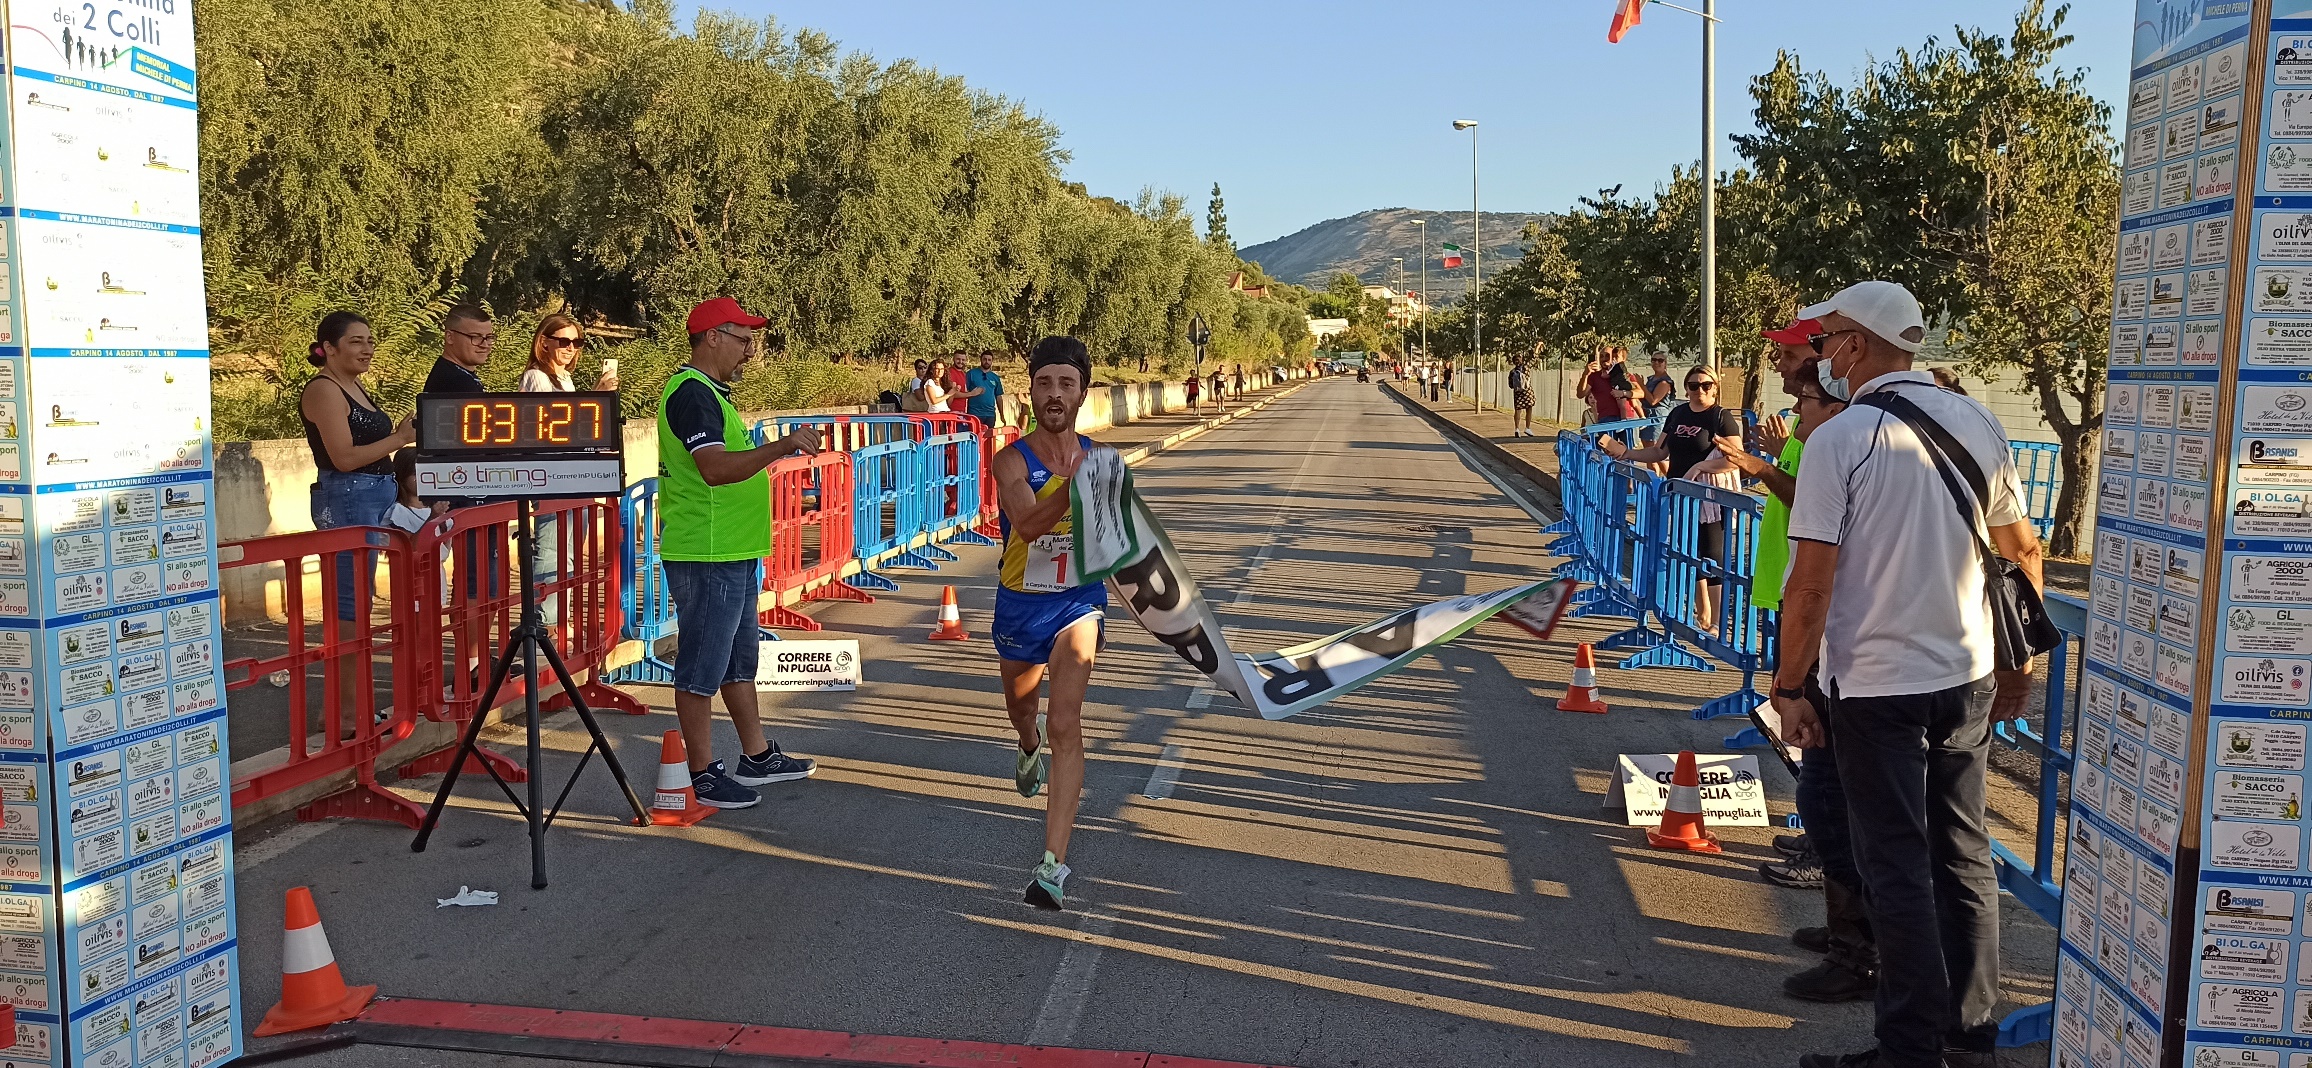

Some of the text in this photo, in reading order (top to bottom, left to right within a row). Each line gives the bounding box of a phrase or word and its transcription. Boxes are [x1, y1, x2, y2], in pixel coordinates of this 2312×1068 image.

[2205, 3, 2225, 17] MICHELE
[2226, 3, 2232, 14] DI
[53, 7, 75, 25] dei
[82, 2, 97, 31] 2
[107, 9, 160, 46] Colli
[136, 51, 171, 72] MEMORIAL
[54, 75, 165, 103] CARPINO 14 AGOSTO, DAL 1987
[2199, 152, 2234, 168] SI allo sport
[2195, 181, 2232, 196] NO alla droga
[70, 349, 178, 358] CARPINO 14 AGOSTO, DAL 1987
[160, 457, 202, 469] NO alla droga
[75, 474, 182, 491] WWW.MARATONINADEI2COLLI.IT
[476, 465, 547, 488] timing
[2250, 492, 2304, 502] BI.OL.GA.
[81, 535, 93, 544] GL
[166, 559, 206, 571] SI allo sport
[1050, 552, 1068, 584] 1
[3, 582, 26, 592] sport
[62, 583, 93, 597] oilivis
[166, 579, 208, 592] NO alla droga
[82, 596, 188, 621] CARPINO 14 AGOSTO, DAL 1987
[191, 606, 201, 614] GL
[2276, 610, 2295, 620] GL
[6, 632, 18, 641] GL
[176, 650, 201, 664] oilivis
[777, 652, 832, 663] CORRERE
[777, 663, 832, 673] IN PUGLIA
[2235, 668, 2284, 683] oilivis
[175, 677, 214, 693] SI allo sport
[756, 678, 852, 687] www.correreinpuglia.it
[175, 697, 216, 714] NO alla droga
[9, 715, 32, 725] sport
[2269, 709, 2312, 719] CARPIN
[93, 717, 197, 751] WWW.MARATONINADEI2COLLI.IT
[151, 739, 162, 748] GL
[2231, 773, 2285, 783] Biomasseria
[2244, 782, 2285, 792] SACCO
[134, 786, 161, 801] oilivis
[181, 796, 220, 814] SI allo sport
[14, 847, 38, 857] sport
[2225, 845, 2251, 855] Hotel
[2267, 848, 2287, 857] Ville
[85, 929, 113, 947] oilivis
[2215, 937, 2269, 950] BI.OL.GA.
[7, 976, 46, 988] allo sport
[103, 952, 207, 1005] WWW.MARATONINADEI2COLLI.IT
[2231, 987, 2279, 998] AGRICOLA
[2240, 994, 2269, 1003] 2000
[2243, 1035, 2310, 1047] CARPINO 14
[2241, 1051, 2260, 1062] GL
